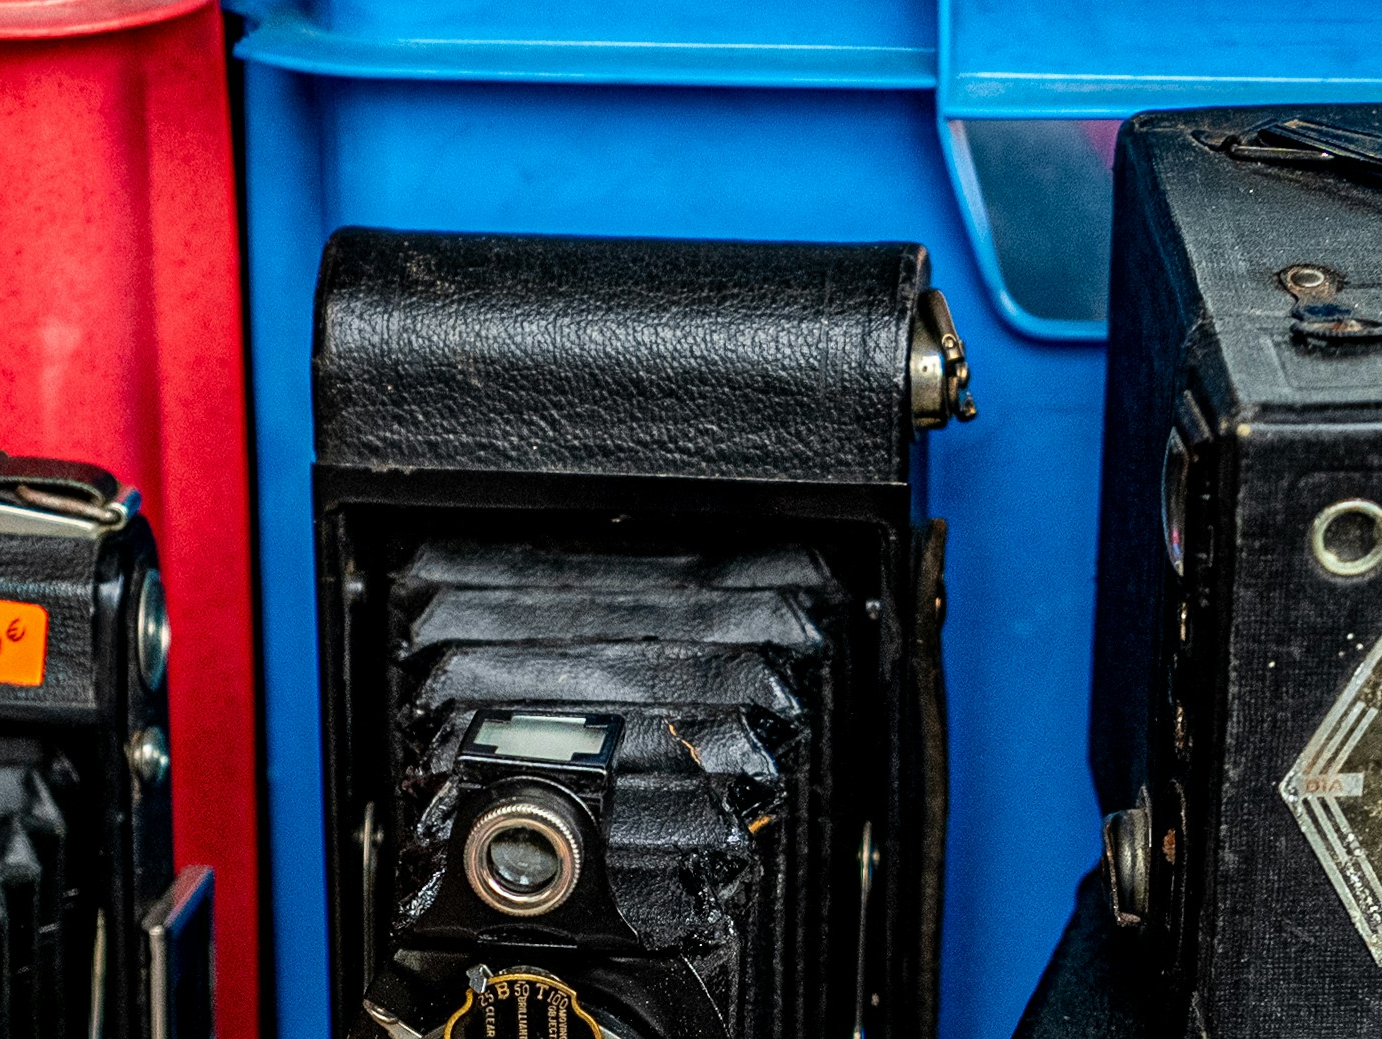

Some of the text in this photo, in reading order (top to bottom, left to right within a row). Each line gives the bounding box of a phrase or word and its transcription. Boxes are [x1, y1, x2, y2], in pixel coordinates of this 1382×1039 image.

[495, 982, 510, 1000] B
[536, 983, 550, 1000] T
[485, 1006, 496, 1038] CLEAR
